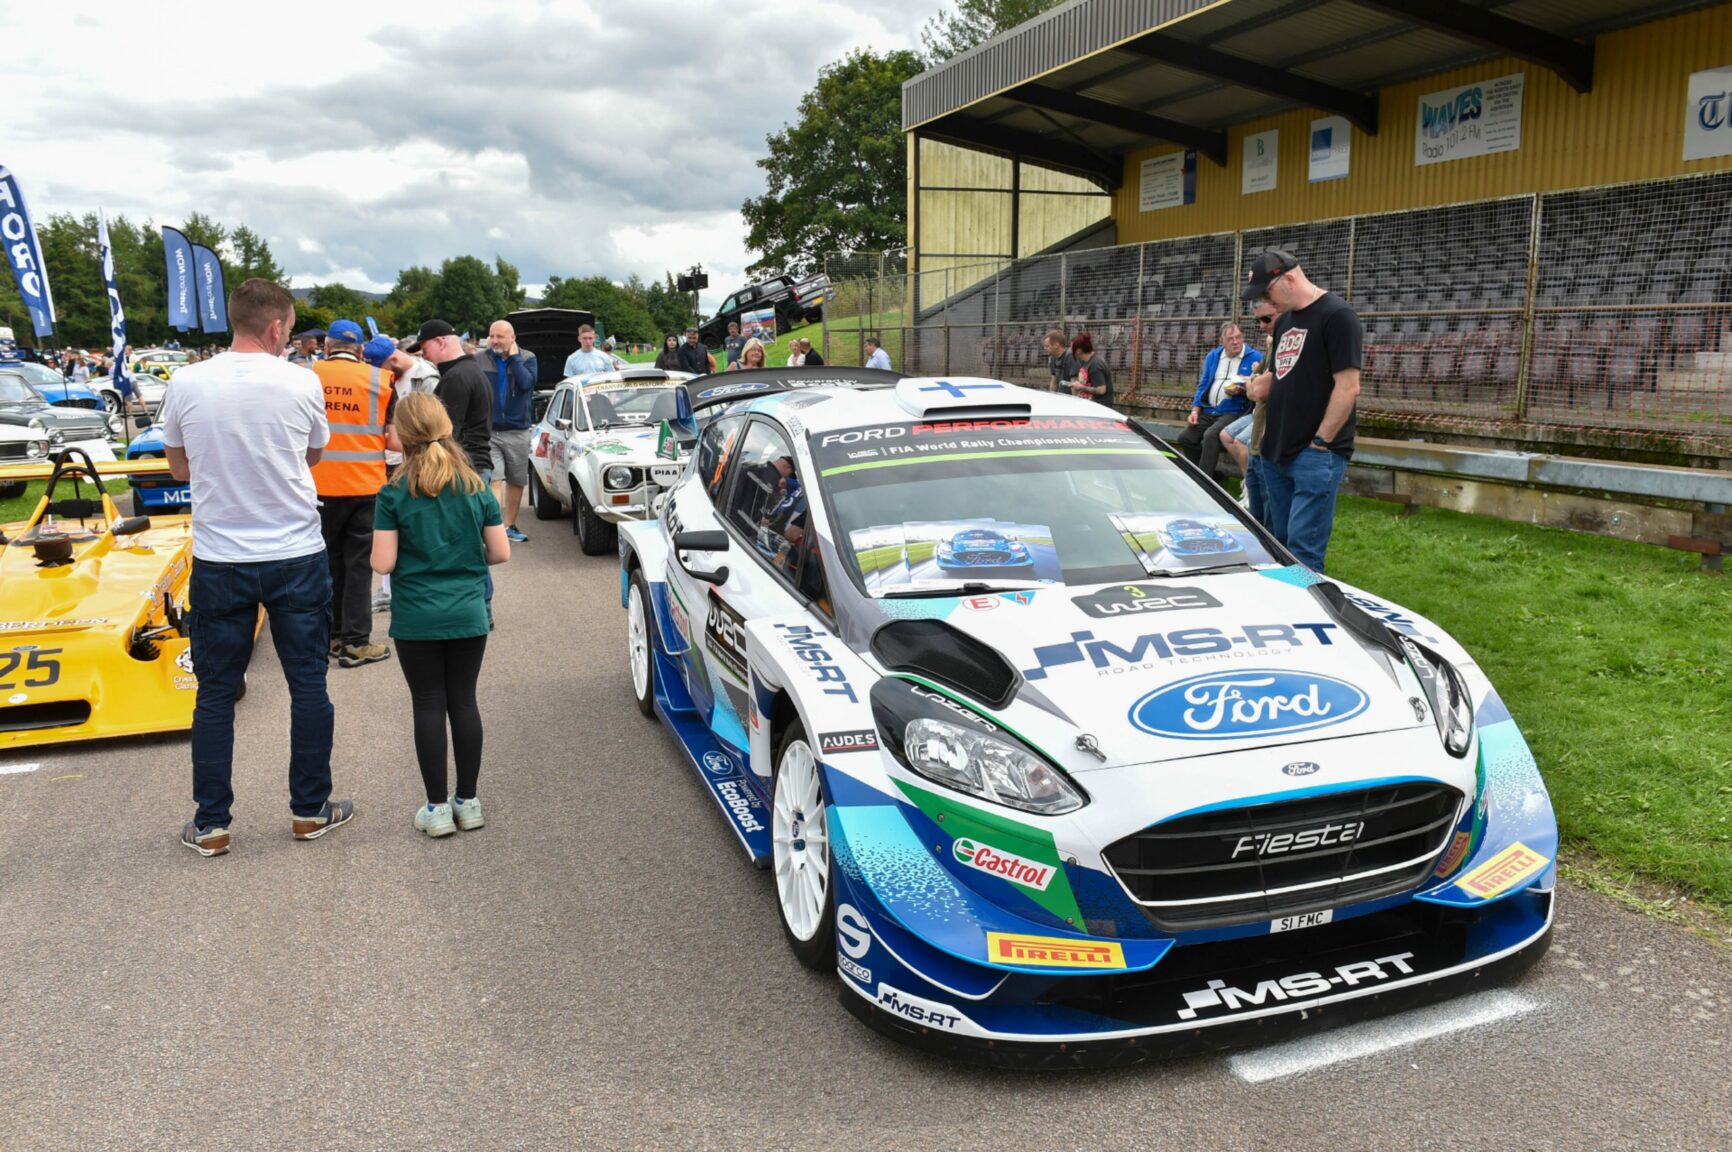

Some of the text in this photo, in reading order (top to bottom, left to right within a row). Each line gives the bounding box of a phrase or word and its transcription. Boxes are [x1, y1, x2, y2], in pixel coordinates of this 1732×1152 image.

[1422, 87, 1482, 137] WAVES
[1468, 124, 1480, 140] FM
[324, 386, 352, 396] GTM
[325, 401, 360, 412] RENA
[822, 419, 1132, 447] FORD PERFORMANCE
[889, 445, 914, 455] FIA
[916, 441, 957, 451] World
[960, 437, 995, 449] Rally
[998, 435, 1088, 447] Championship
[1095, 595, 1208, 614] WRC
[1124, 585, 1146, 598] 3
[1083, 622, 1337, 668] MS-RT
[0, 648, 64, 689] 25
[783, 633, 859, 704] MS-RT
[1097, 648, 1293, 677] ROAD TECHNOLOGY
[910, 685, 998, 733] LAZER
[1183, 676, 1332, 731] Ford
[822, 733, 876, 747] AUDES
[1287, 762, 1317, 776] Ford
[716, 781, 766, 833] EcoBoost
[1231, 821, 1364, 859] Fiesta
[973, 847, 1049, 887] Castrol
[1466, 849, 1537, 893] PIRELLI
[1298, 911, 1324, 928] FMC
[998, 938, 1111, 963] PIRELLI
[1218, 951, 1415, 1010] MS-RT
[890, 1000, 961, 1029] MS-RT
